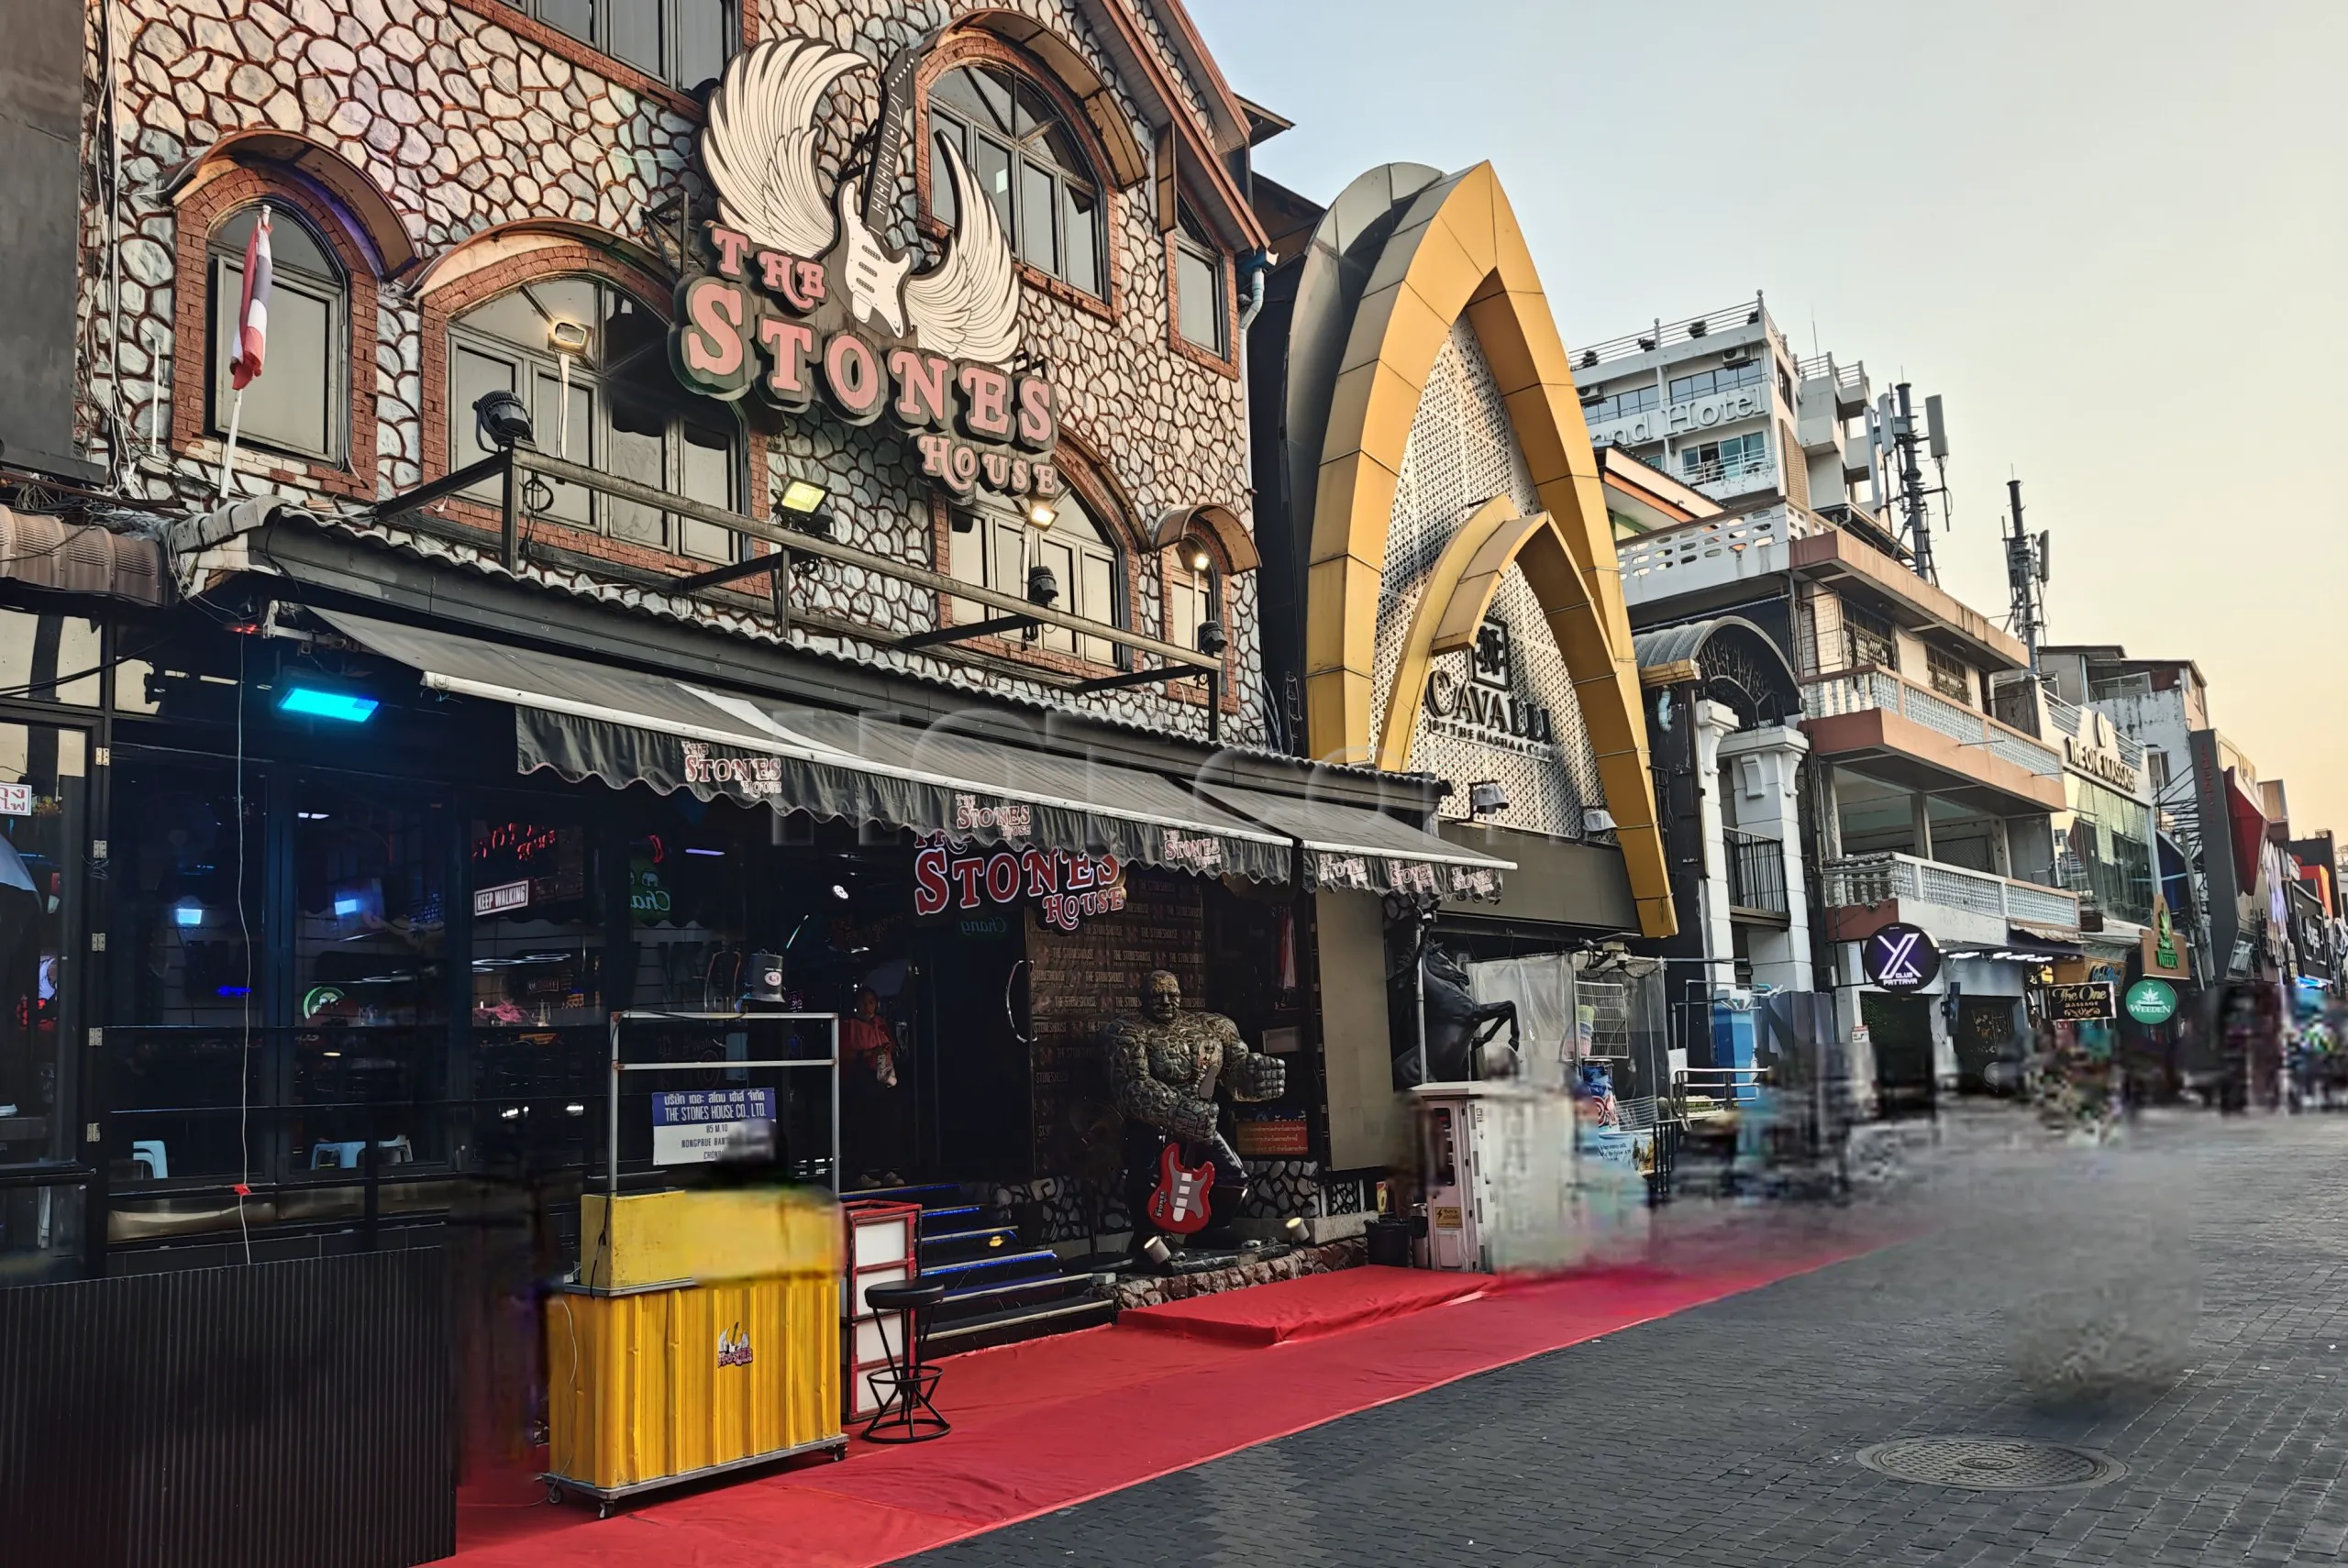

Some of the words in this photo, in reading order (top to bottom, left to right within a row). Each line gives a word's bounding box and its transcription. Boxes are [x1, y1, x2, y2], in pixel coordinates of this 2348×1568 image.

[712, 227, 826, 309] THE
[688, 282, 1054, 442] STONES
[1661, 385, 1766, 437] Hotel
[919, 434, 1059, 494] HOUSE
[1425, 670, 1554, 745] CAVALLI
[681, 741, 708, 759] THE
[1432, 719, 1446, 733] BY
[1449, 723, 1474, 740] THE
[1476, 730, 1524, 753] NASHAA
[2065, 736, 2085, 768] THE
[685, 755, 781, 782] STONES
[957, 805, 1031, 830] STONES
[914, 847, 1121, 915] STONES
[477, 894, 493, 911] KEEP
[494, 885, 526, 907] WALKING
[1042, 887, 1124, 931] HOUSE
[1883, 977, 1918, 986] PATTAYA
[2052, 986, 2077, 1004] The
[2078, 985, 2108, 1001] One
[2129, 1004, 2171, 1014] WEEDEN
[665, 1107, 680, 1121] THE
[681, 1105, 709, 1121] STONES
[711, 1104, 735, 1120] HOUSE
[681, 1137, 712, 1148] NONGPRUE
[714, 1137, 727, 1146] BAN
